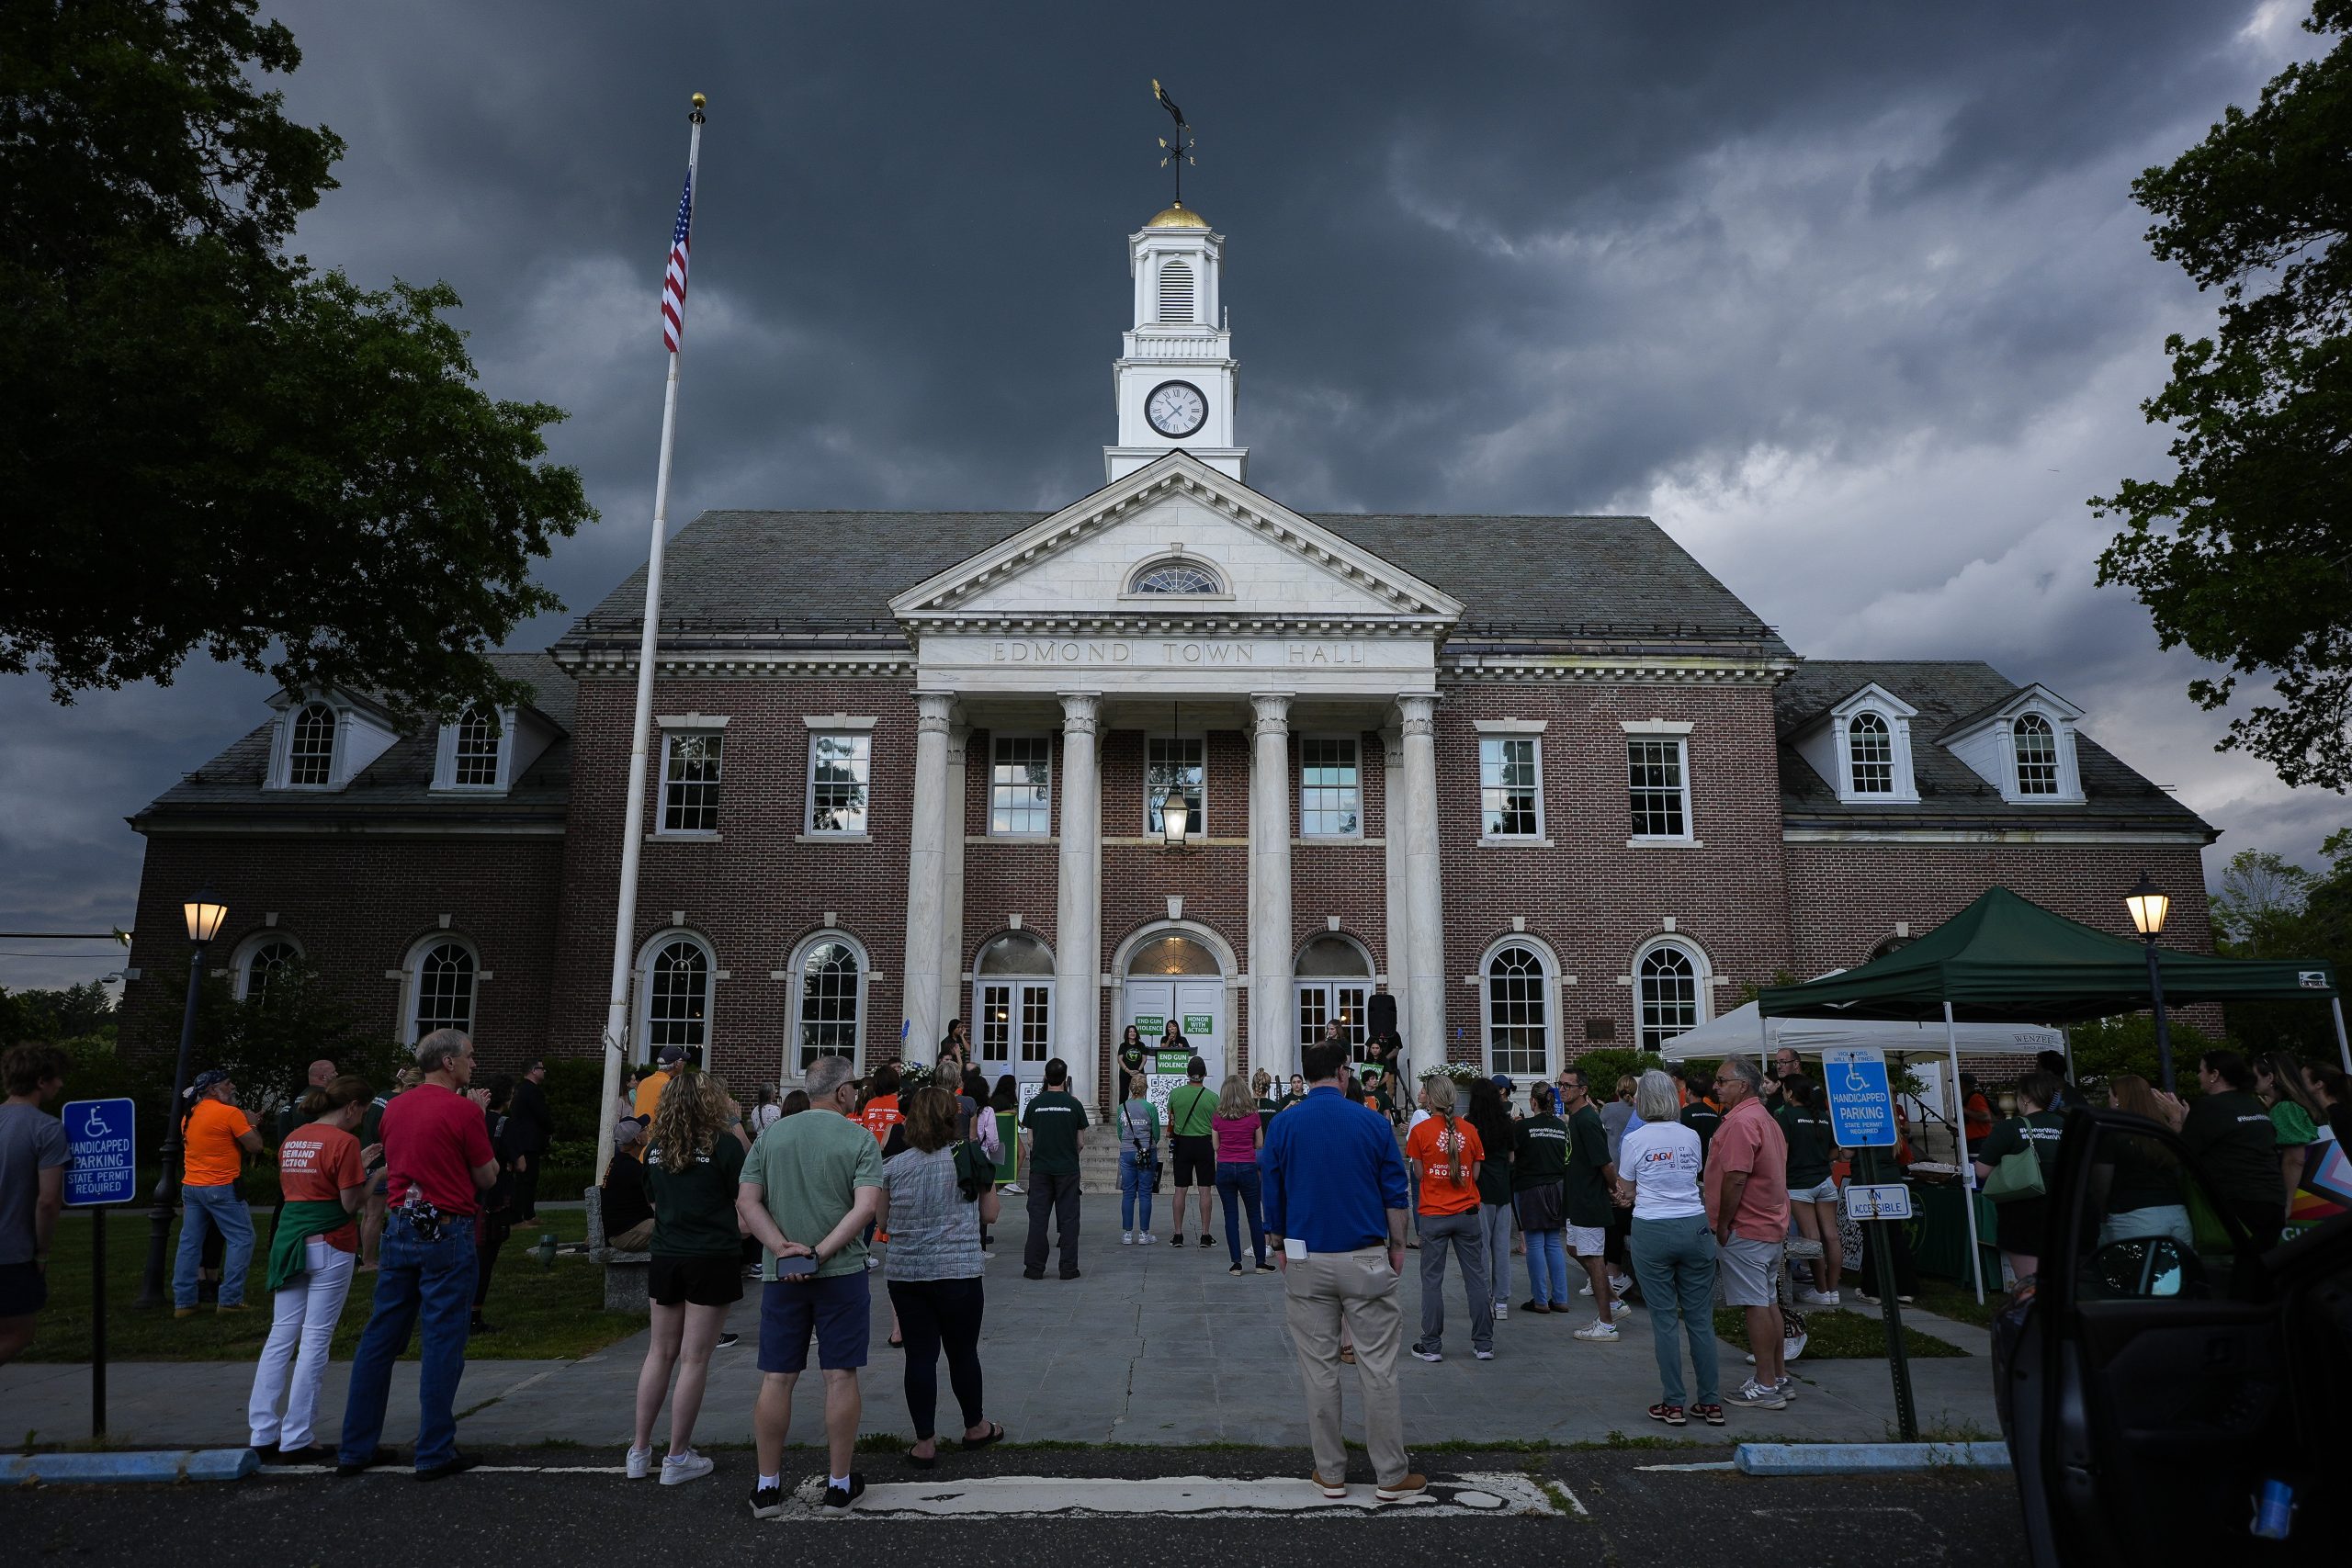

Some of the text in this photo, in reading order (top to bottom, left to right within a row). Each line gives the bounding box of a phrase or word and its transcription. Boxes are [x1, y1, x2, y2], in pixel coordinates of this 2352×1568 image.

[993, 643, 1362, 663] EDMOND TOWN HALL
[1833, 1092, 1886, 1103] HANDICAPPED
[1839, 1106, 1884, 1120] PARKING
[69, 1138, 130, 1155] HANDICAPPED
[284, 1141, 307, 1149] MOMS
[282, 1150, 315, 1158] DEMAND
[1645, 1152, 1672, 1162] CAGV
[74, 1153, 124, 1169] PARKING
[281, 1159, 308, 1168] ACTION
[68, 1170, 130, 1184] STATE PERMIT
[1429, 1168, 1470, 1177] PROSE
[76, 1181, 121, 1194] REQUIRED
[1866, 1191, 1882, 1201] VAN
[1855, 1202, 1902, 1213] ACCESSIBLE
